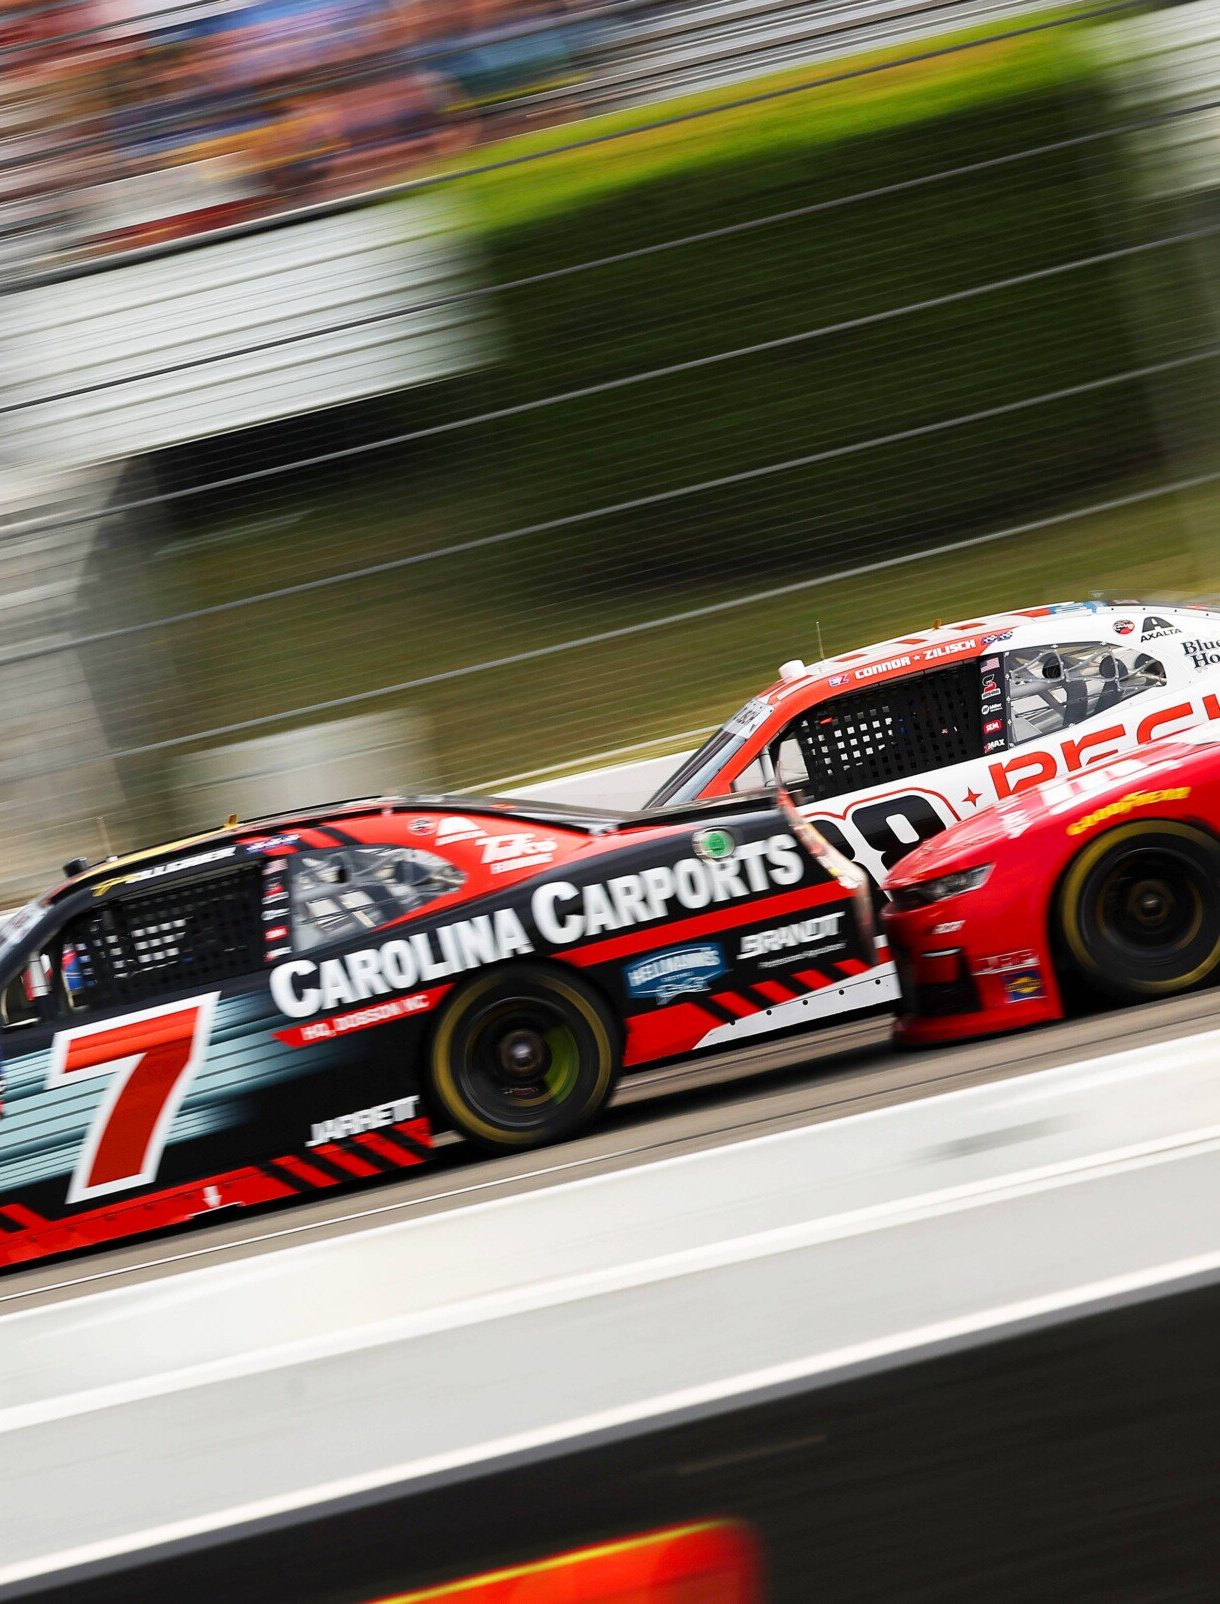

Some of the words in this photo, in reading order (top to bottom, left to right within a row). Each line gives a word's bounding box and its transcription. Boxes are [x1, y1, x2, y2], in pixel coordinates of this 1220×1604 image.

[855, 655, 911, 680] CONNOR
[923, 638, 976, 661] ZILISCH
[1140, 628, 1182, 643] AXALTA
[269, 907, 536, 1019] CAROLINA
[531, 833, 805, 945] CARPORTS
[44, 990, 222, 1205] 7
